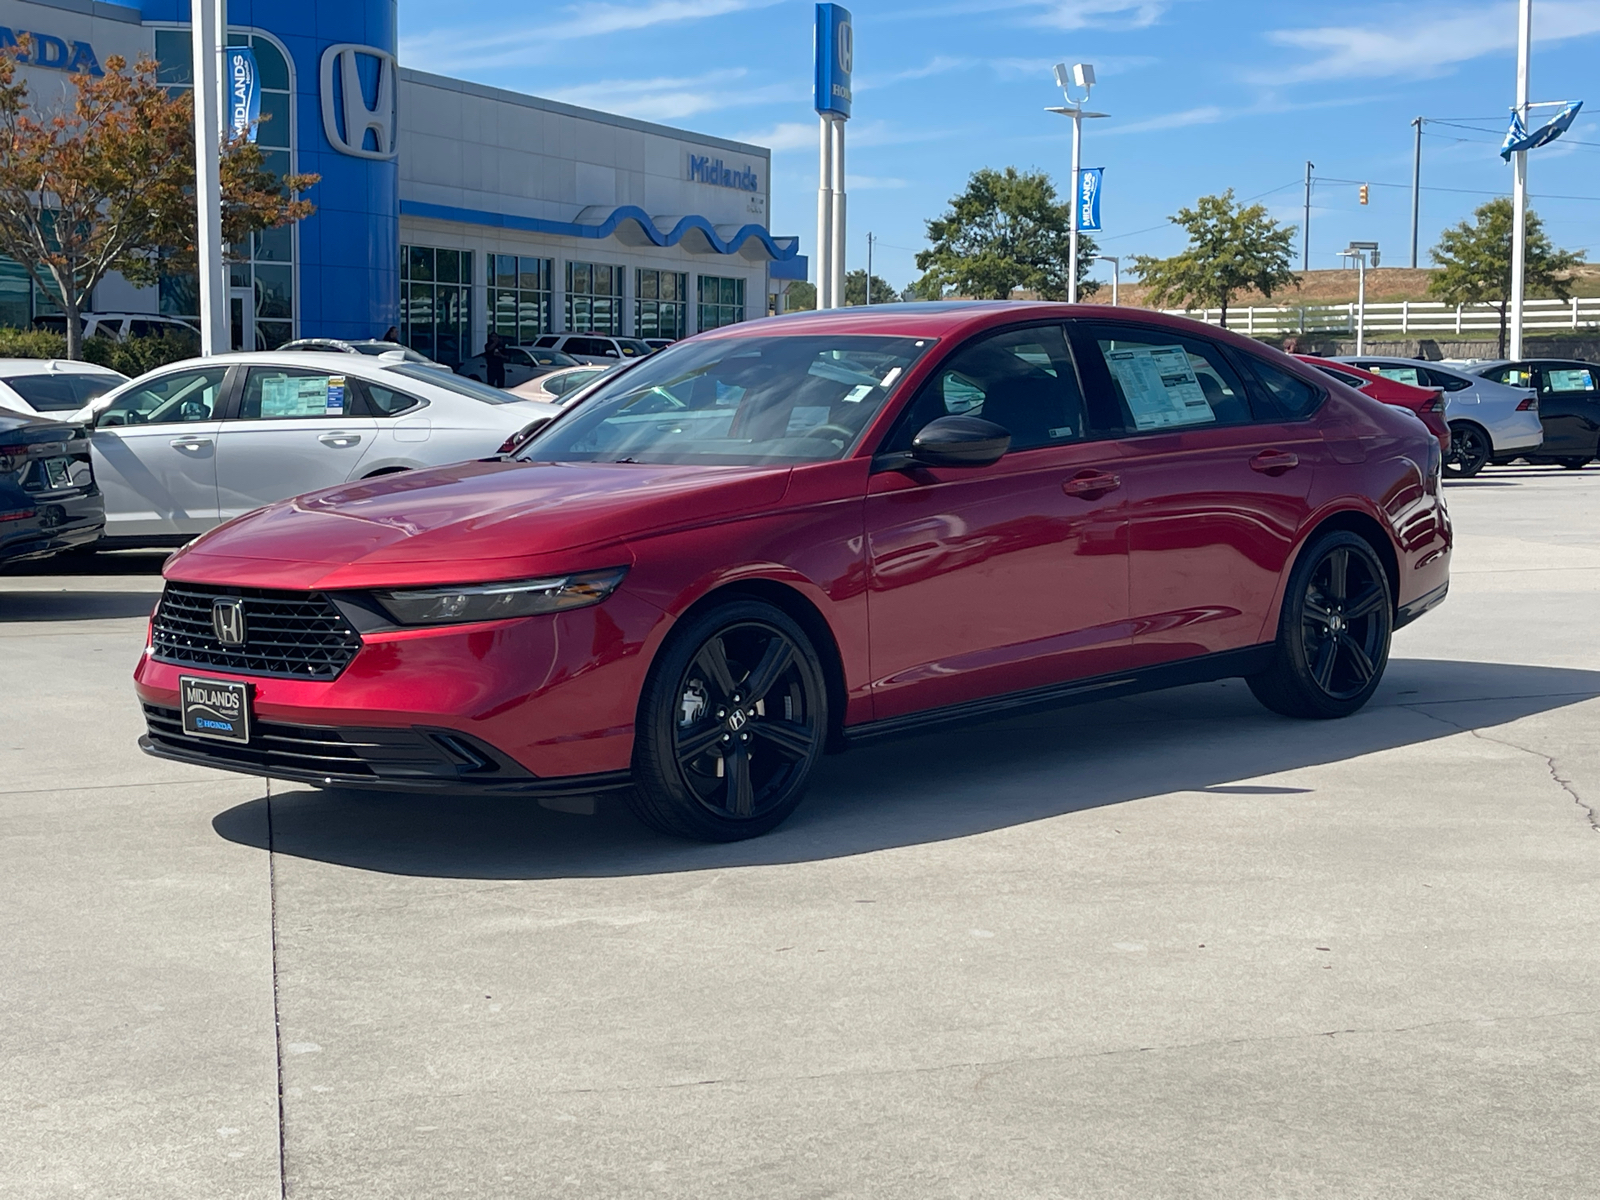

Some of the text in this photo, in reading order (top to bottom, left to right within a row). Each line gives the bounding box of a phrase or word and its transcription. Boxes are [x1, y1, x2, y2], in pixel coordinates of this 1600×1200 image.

[233, 54, 246, 135] MIDLANDS
[690, 154, 758, 192] Midlands
[1082, 172, 1092, 227] MIDLANDS
[187, 687, 240, 709] MIDLANDS
[204, 719, 233, 731] HONDA
